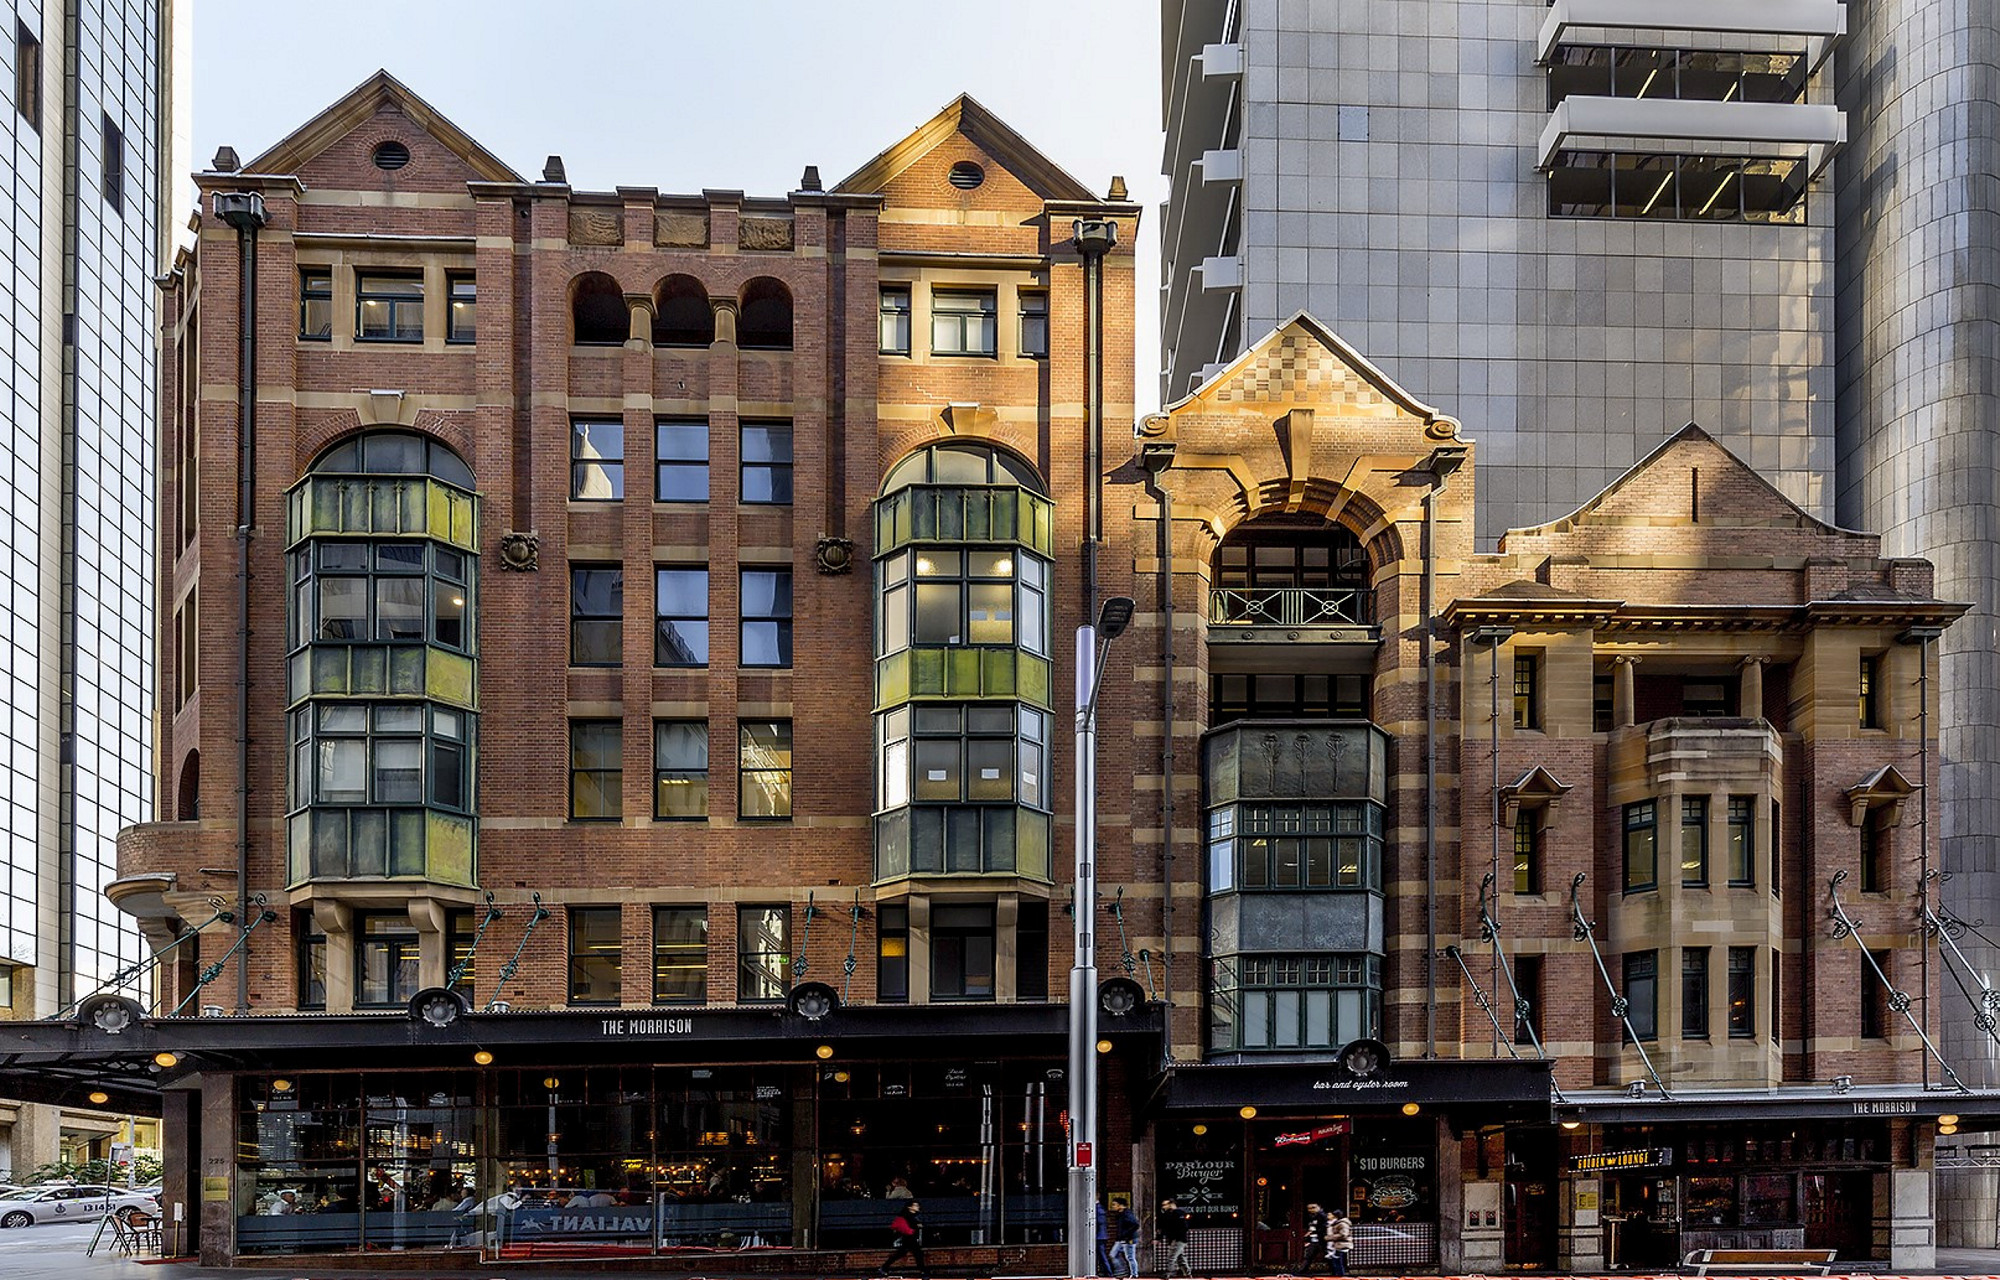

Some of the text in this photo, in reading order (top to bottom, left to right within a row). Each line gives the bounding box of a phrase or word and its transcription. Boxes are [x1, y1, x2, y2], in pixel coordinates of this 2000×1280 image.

[602, 1018, 692, 1035] THE MORRISON
[1313, 1079, 1409, 1091] bar and oyster room
[1853, 1101, 1917, 1114] THE MORRISON
[1165, 1160, 1235, 1170] PARLOUR
[1379, 1156, 1425, 1170] BURGERS
[1617, 1151, 1648, 1166] LOUNGE
[1177, 1166, 1223, 1185] Burger
